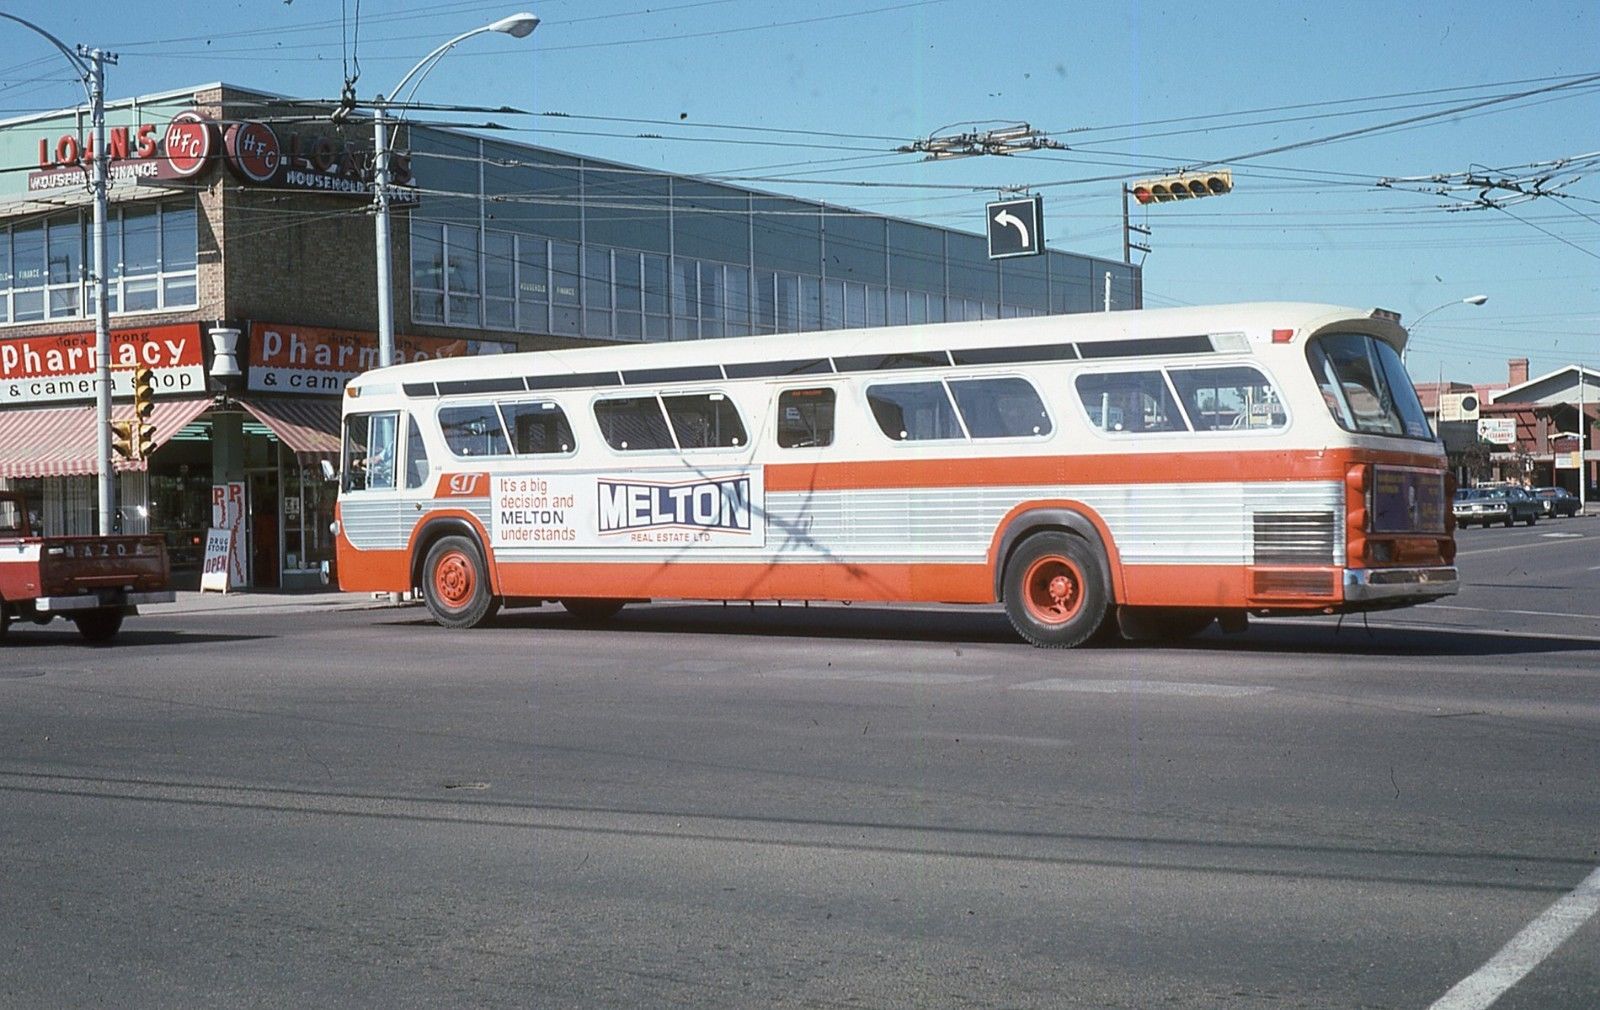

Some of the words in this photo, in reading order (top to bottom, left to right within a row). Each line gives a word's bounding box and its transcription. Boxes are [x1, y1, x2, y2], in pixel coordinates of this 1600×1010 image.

[169, 128, 199, 158] HFC
[244, 133, 276, 168] HFC
[30, 169, 94, 190] HOUSEHOL
[287, 170, 365, 193] HOUSEHOLD
[264, 373, 277, 386] &
[9, 383, 21, 397] &
[500, 478, 517, 492] It's
[520, 482, 527, 492] a
[530, 478, 548, 495] big
[501, 495, 548, 509] decision
[552, 495, 574, 508] and
[600, 479, 749, 530] MELTON
[501, 510, 564, 525] MELTON
[501, 527, 576, 541] understands
[631, 533, 653, 543] REAL
[656, 533, 690, 542] ESTATE
[65, 544, 144, 557] MAZDA
[205, 555, 227, 573] OPEN
